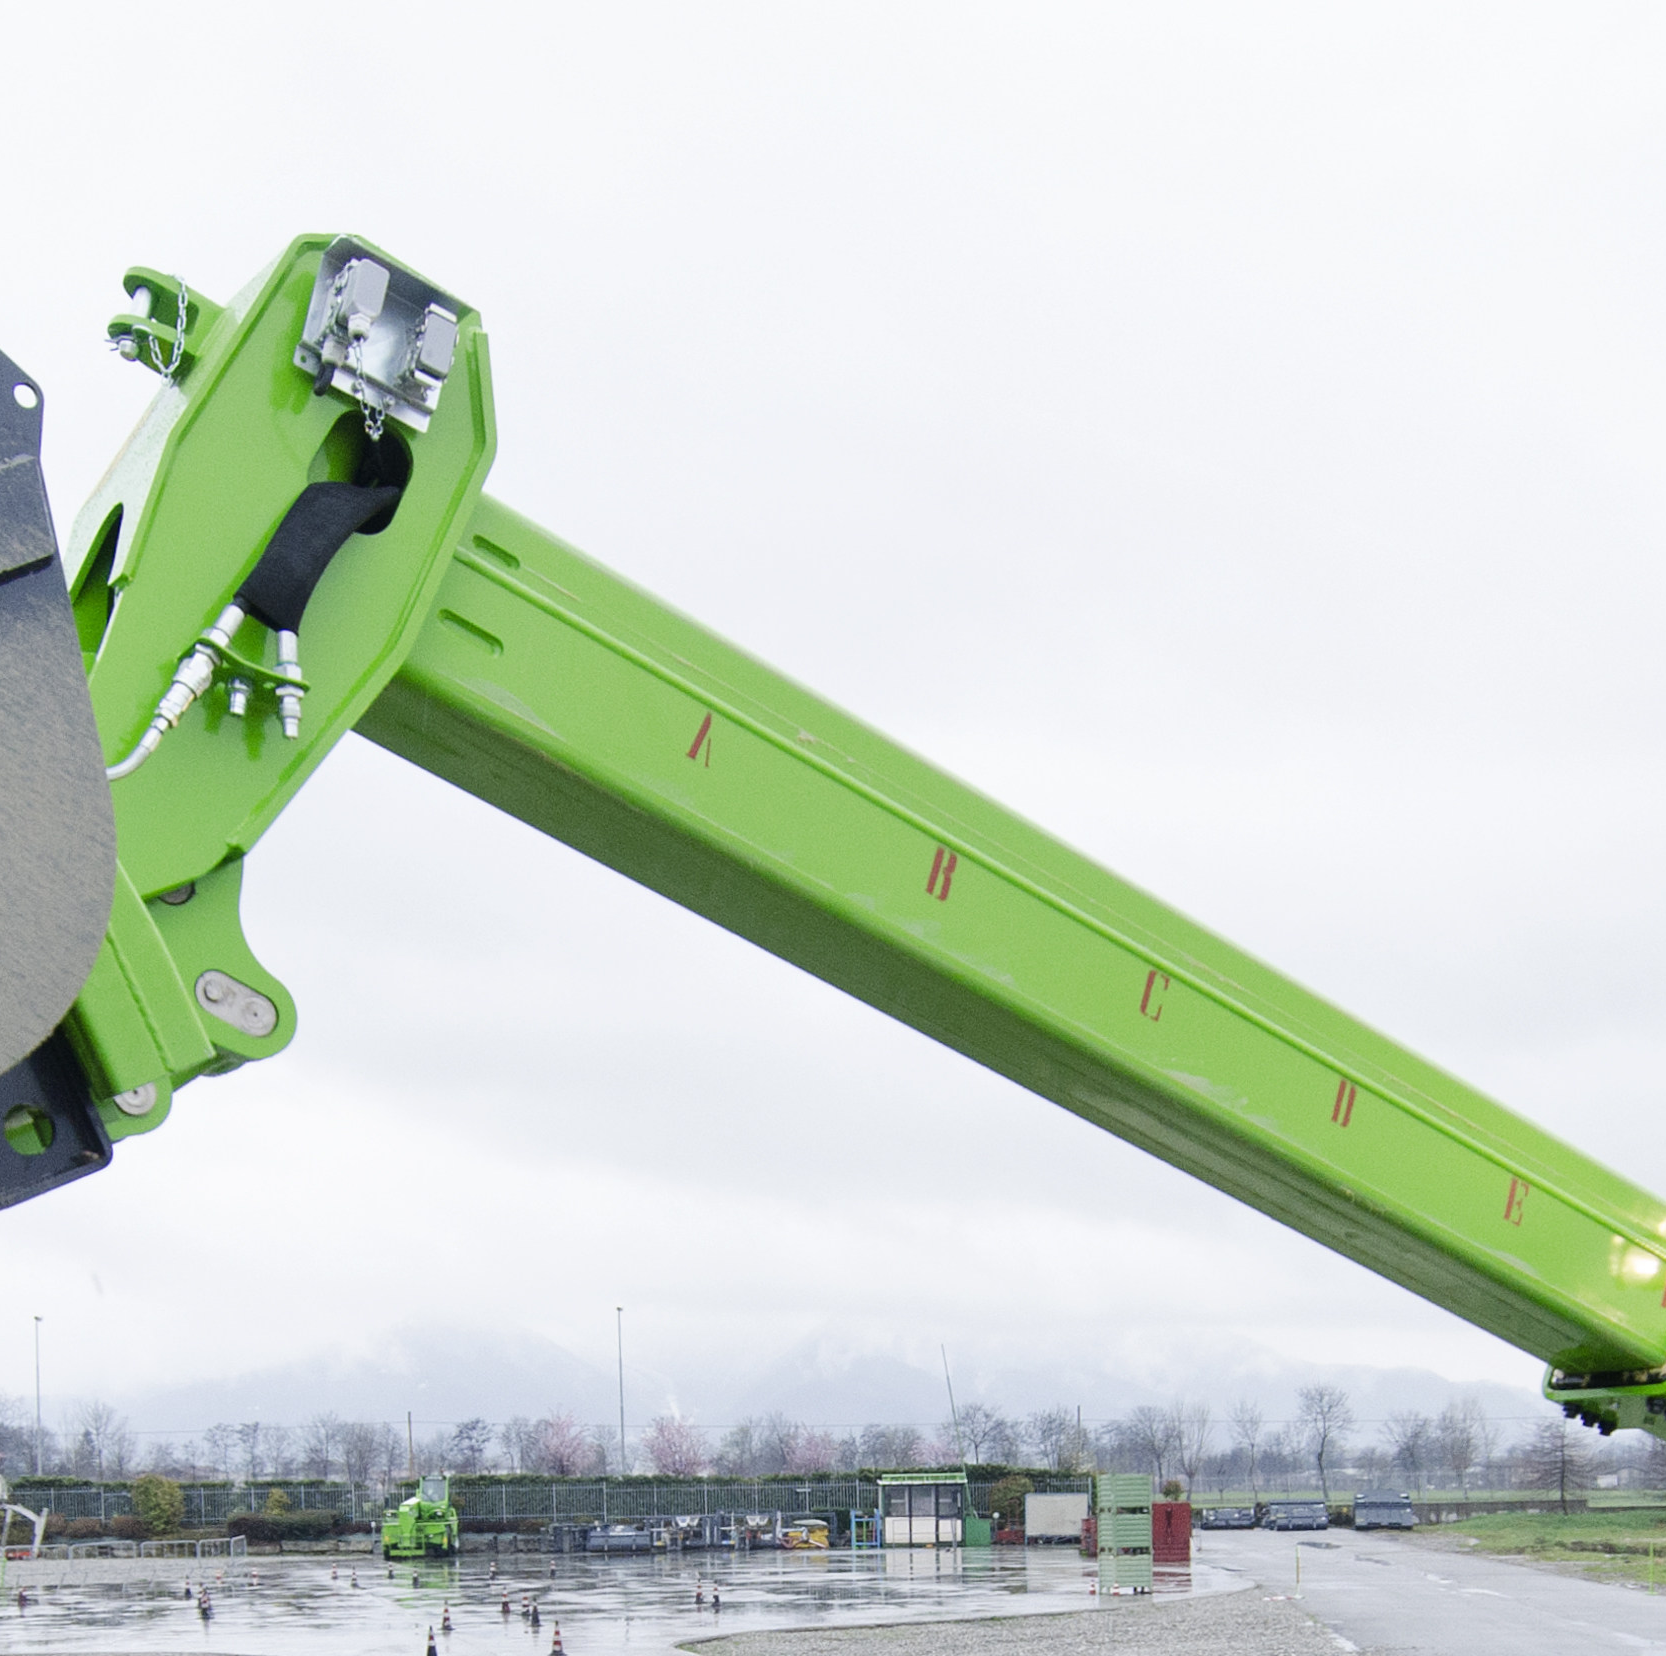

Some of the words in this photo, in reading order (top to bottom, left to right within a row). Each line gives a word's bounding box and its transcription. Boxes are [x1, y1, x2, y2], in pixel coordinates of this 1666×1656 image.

[926, 847, 957, 901] B
[1140, 970, 1170, 1021] C
[1332, 1079, 1356, 1127] D
[1504, 1177, 1529, 1225] E
